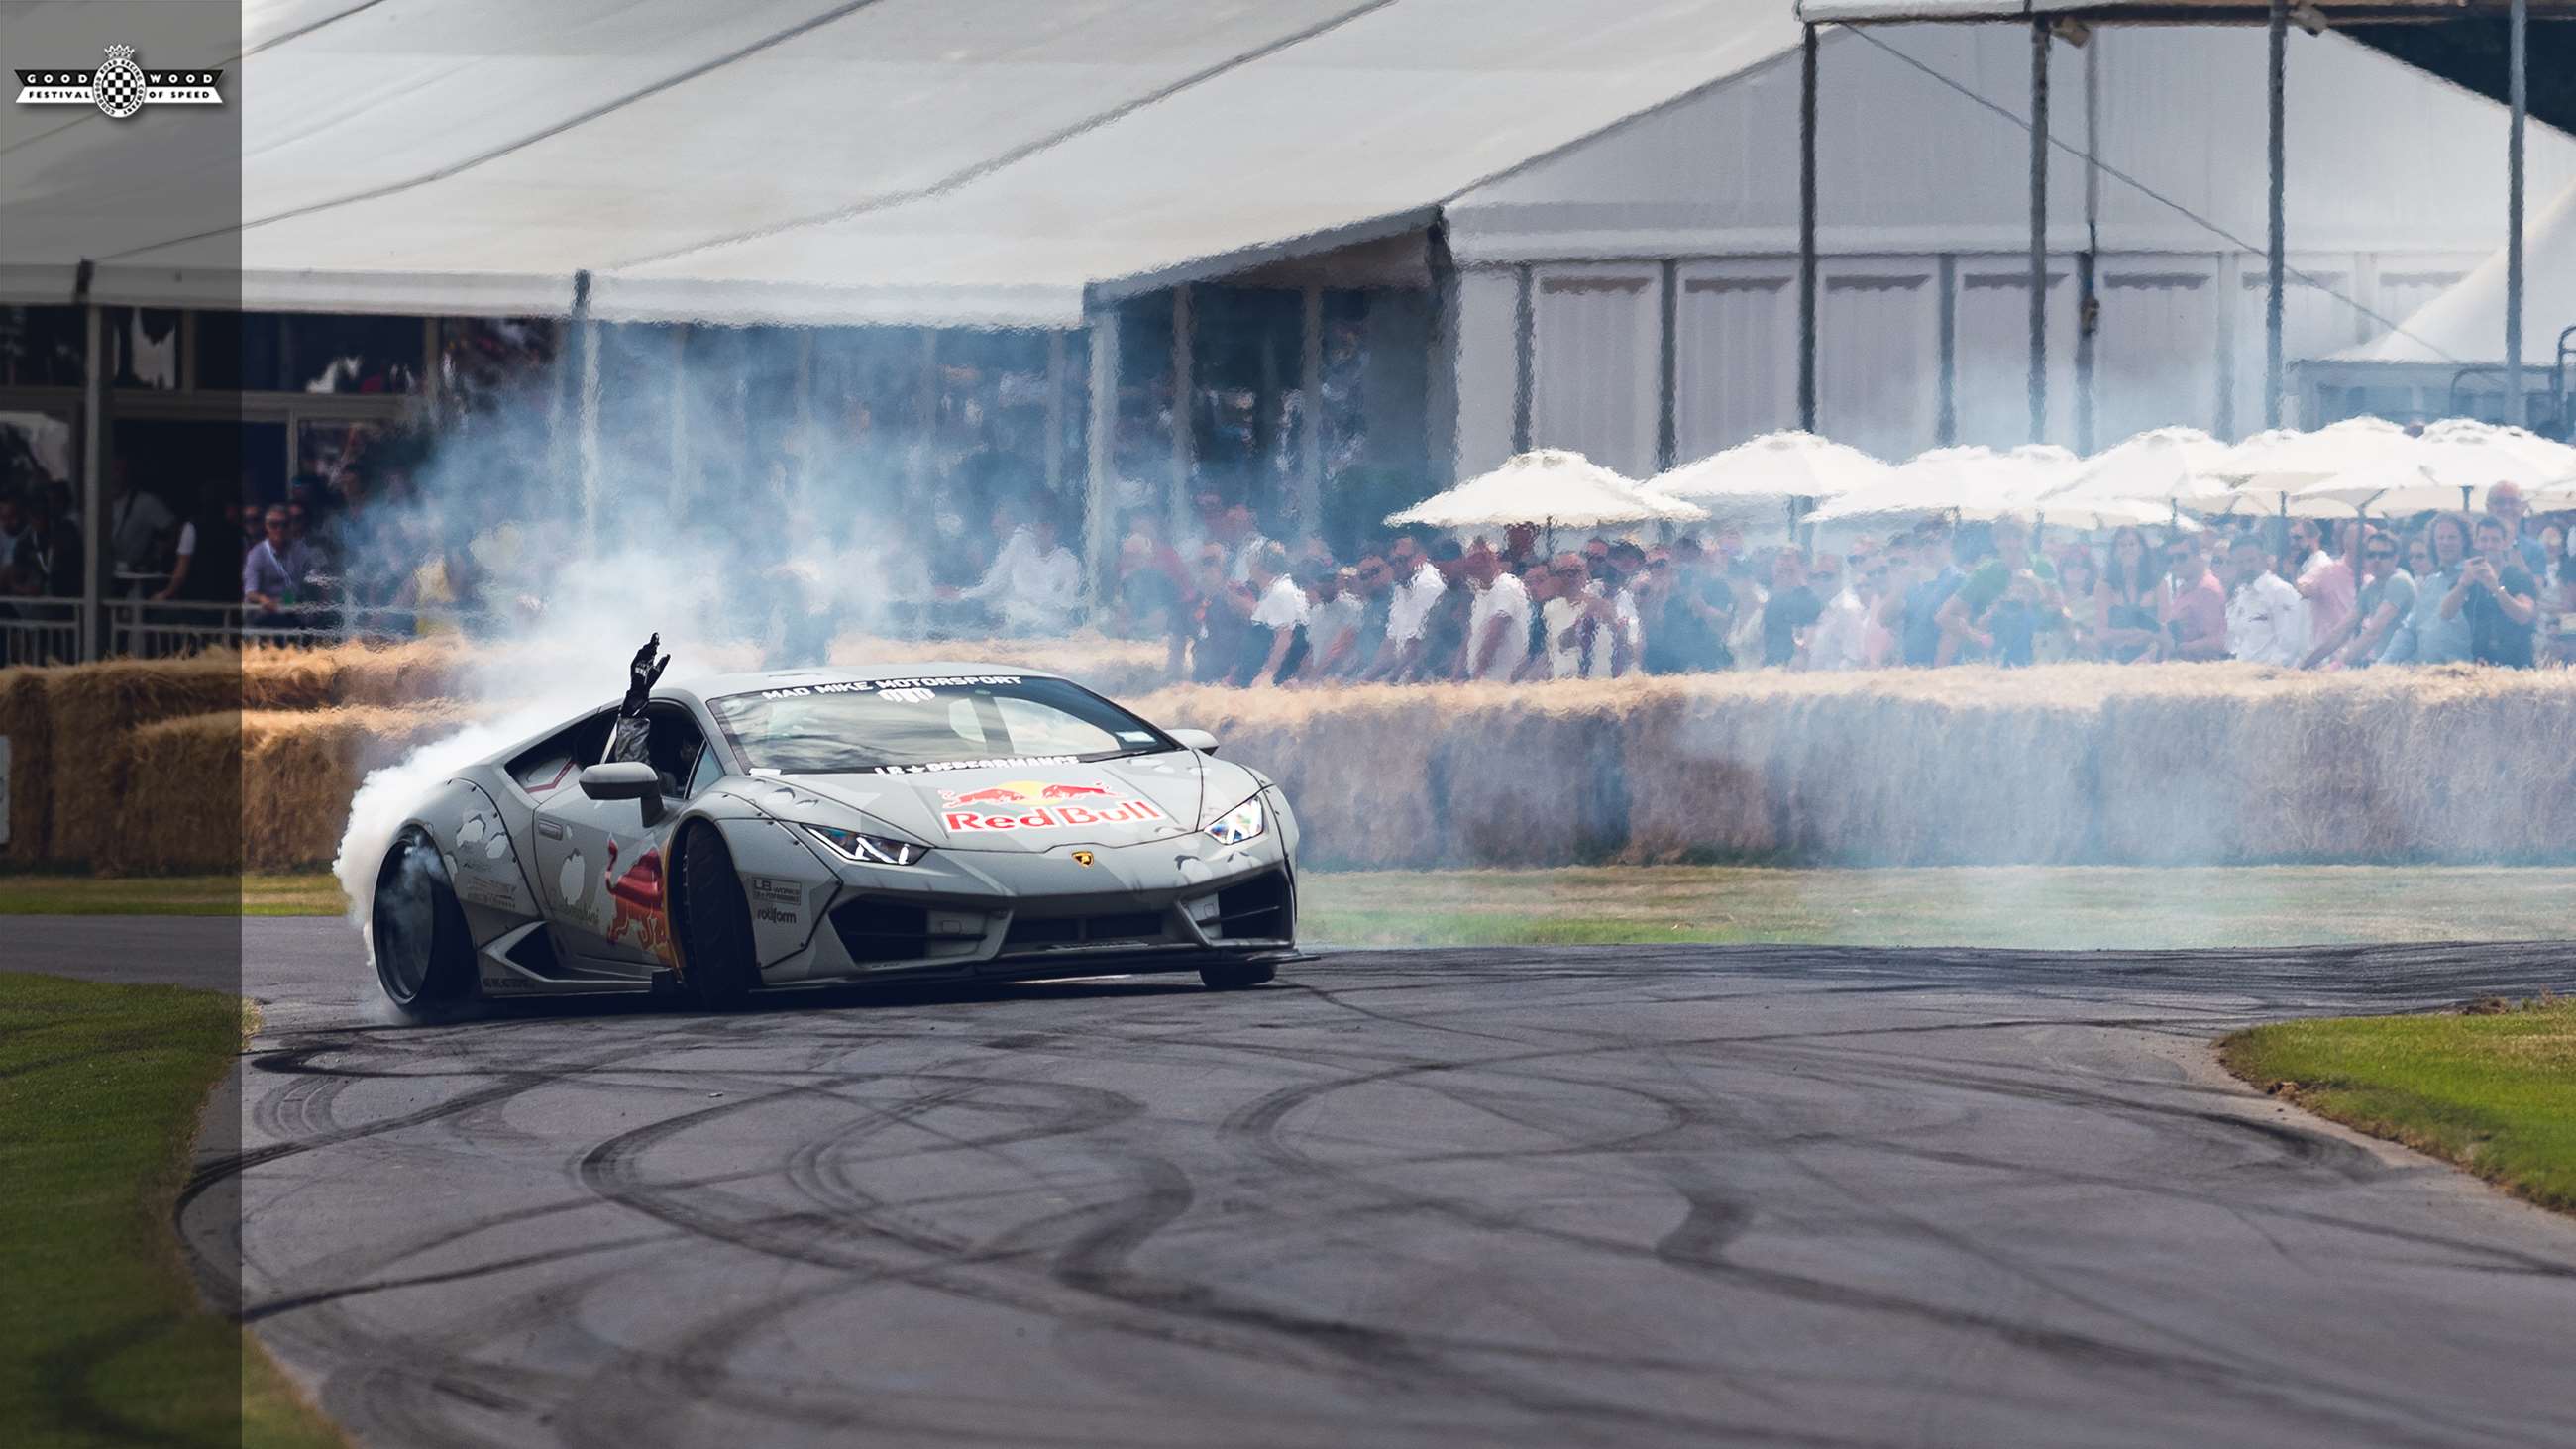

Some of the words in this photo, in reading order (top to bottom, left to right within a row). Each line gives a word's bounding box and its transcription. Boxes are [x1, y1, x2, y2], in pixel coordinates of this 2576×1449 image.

[761, 687, 810, 701] MAD
[814, 681, 874, 695] MIKE
[875, 675, 1023, 689] MOTORSPORT
[945, 807, 1056, 831] Red
[1056, 800, 1162, 825] Bull
